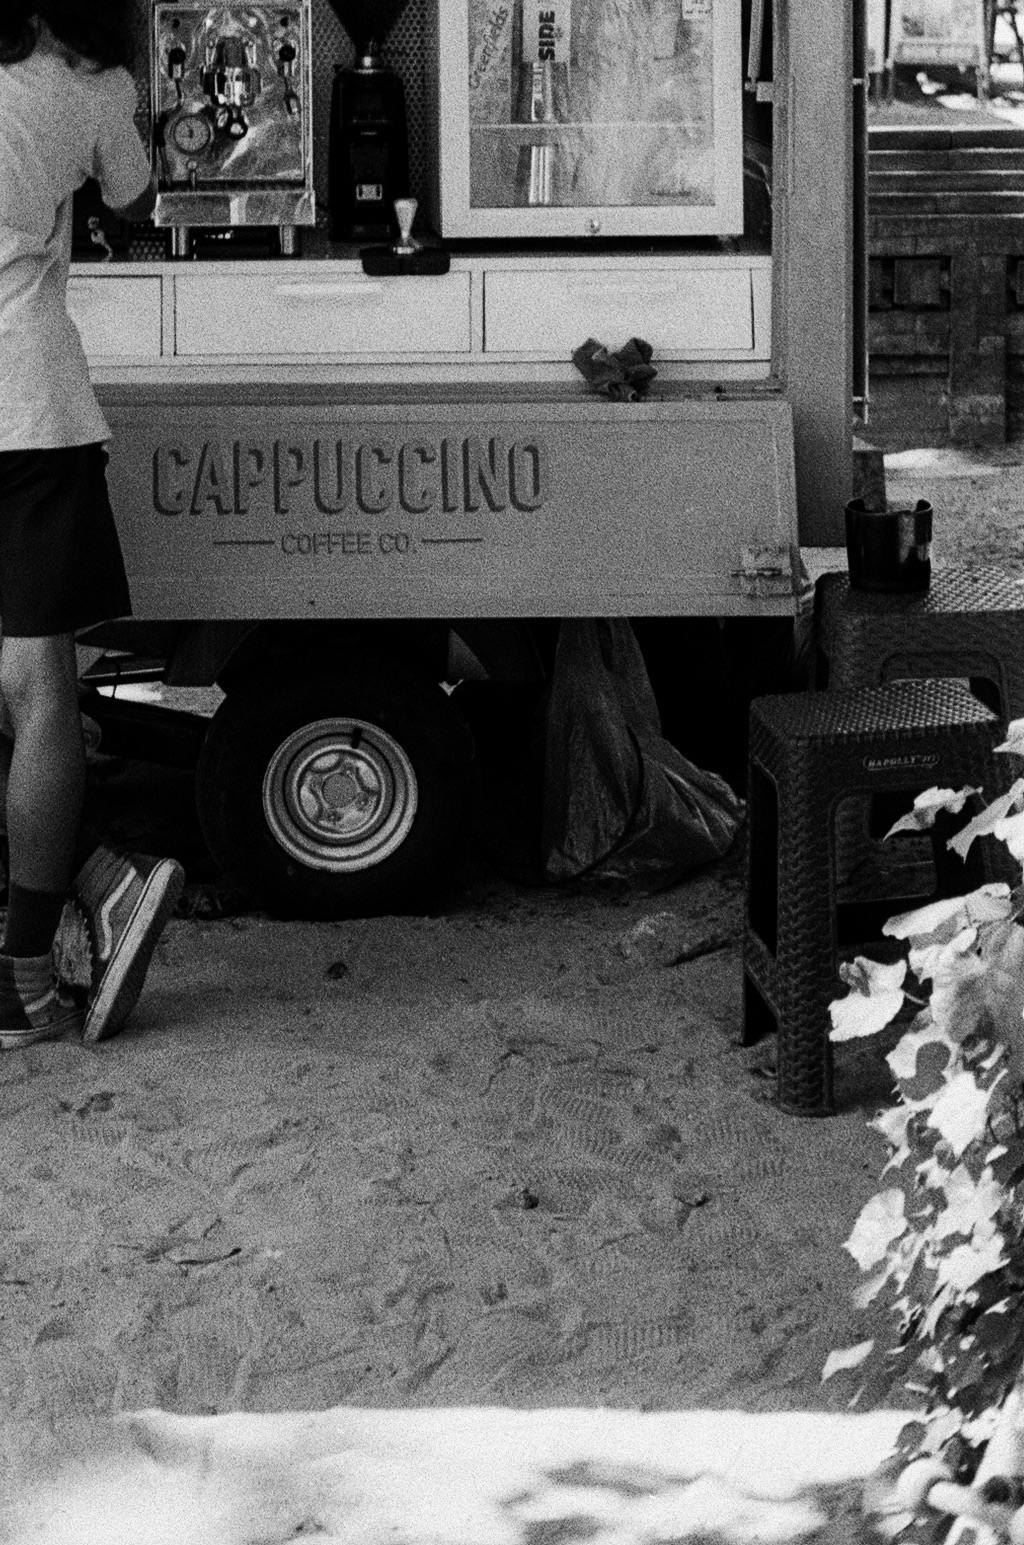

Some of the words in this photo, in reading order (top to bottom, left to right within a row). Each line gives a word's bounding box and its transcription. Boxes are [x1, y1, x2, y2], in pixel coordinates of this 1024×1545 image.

[538, 10, 555, 61] SIDE
[151, 436, 546, 516] CAPPUCCINO
[280, 533, 371, 555] COFFEE
[378, 532, 417, 554] CO.
